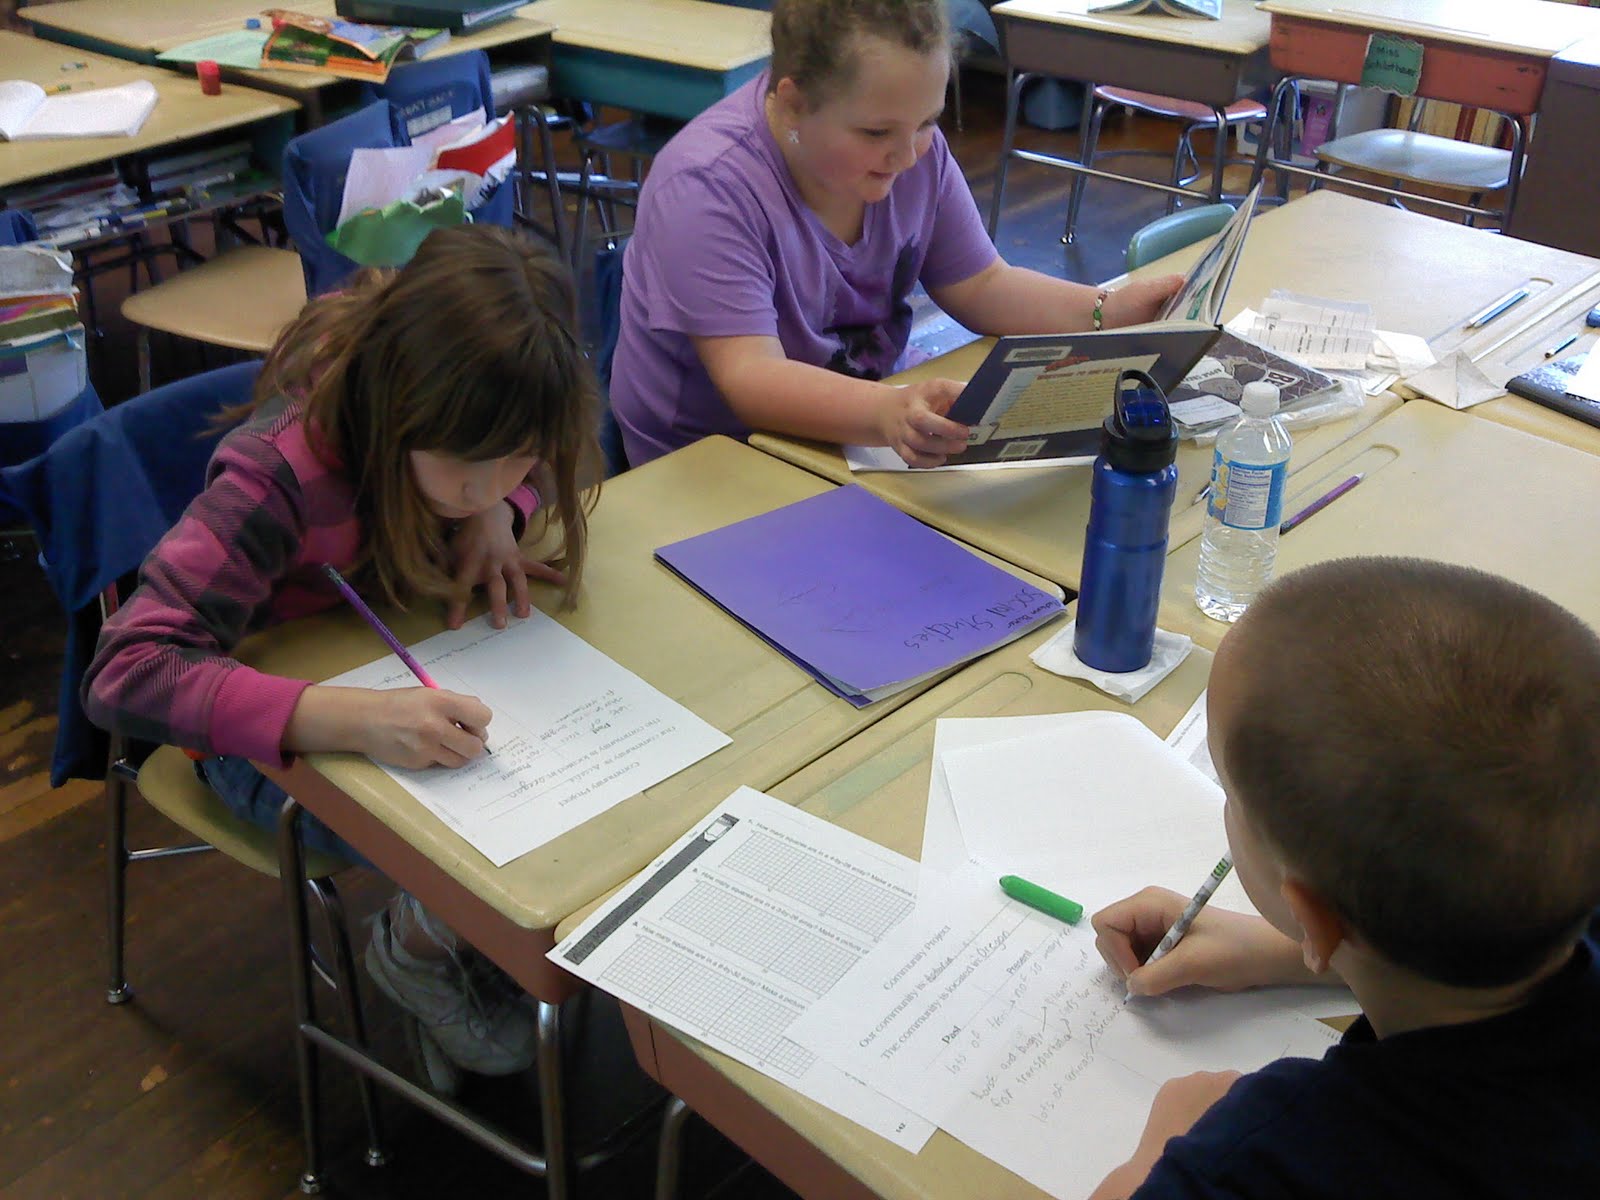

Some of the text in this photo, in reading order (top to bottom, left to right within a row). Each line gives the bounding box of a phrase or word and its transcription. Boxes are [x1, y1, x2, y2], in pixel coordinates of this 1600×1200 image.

[592, 722, 611, 734] Past
[883, 925, 951, 990] Community Project
[1006, 950, 1031, 975] Present
[859, 1032, 876, 1047] Our
[876, 992, 918, 1032] community
[880, 1043, 900, 1059] The
[899, 1001, 941, 1042] community
[945, 966, 974, 993] located
[941, 1025, 961, 1044] Past
